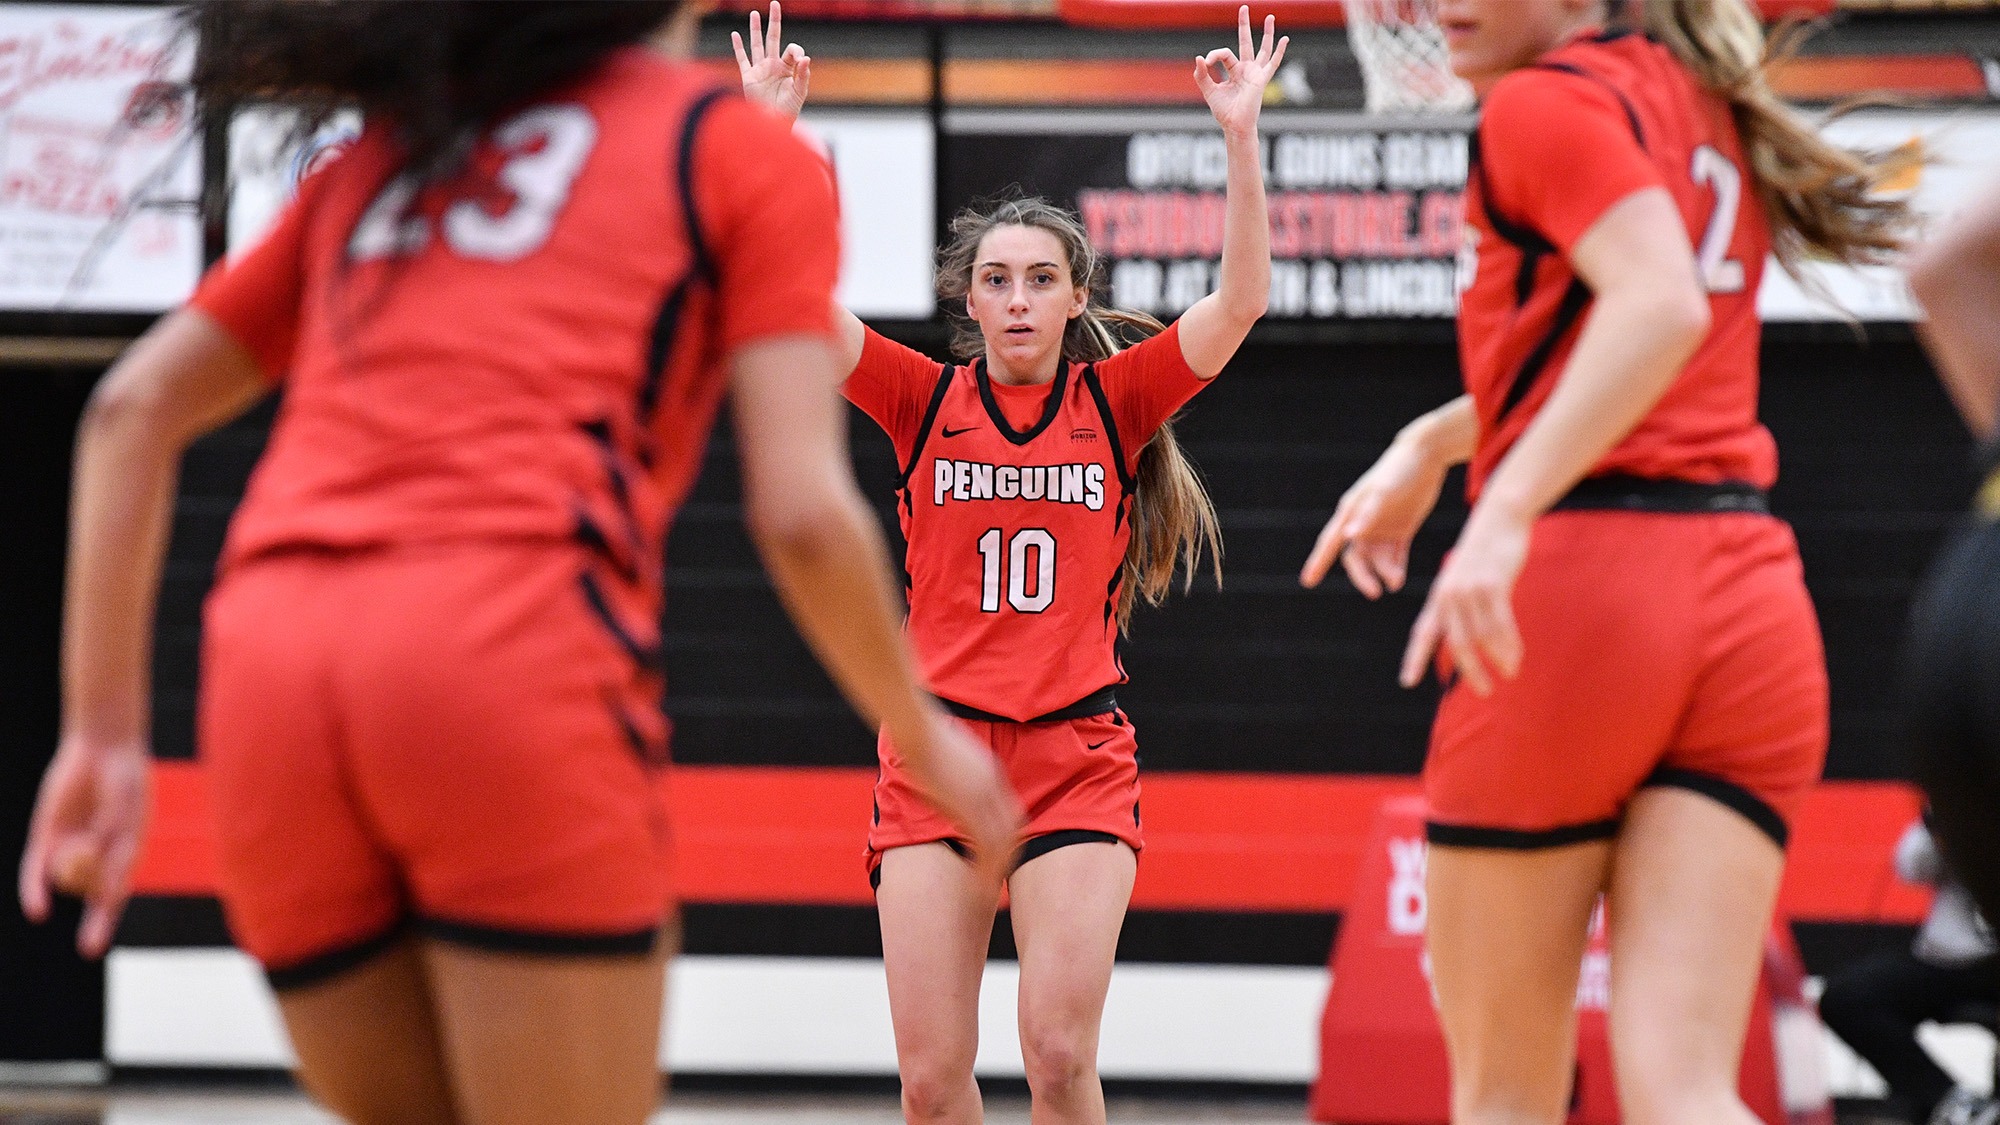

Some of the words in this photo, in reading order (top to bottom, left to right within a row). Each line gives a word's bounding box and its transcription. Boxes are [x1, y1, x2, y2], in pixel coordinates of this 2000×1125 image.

[1126, 133, 1271, 190] OFFICIL
[1691, 146, 1745, 293] 2
[1309, 259, 1338, 316] &
[1342, 259, 1456, 317] LINCOL
[934, 457, 1105, 511] PENGUINS
[977, 527, 1057, 614] 10
